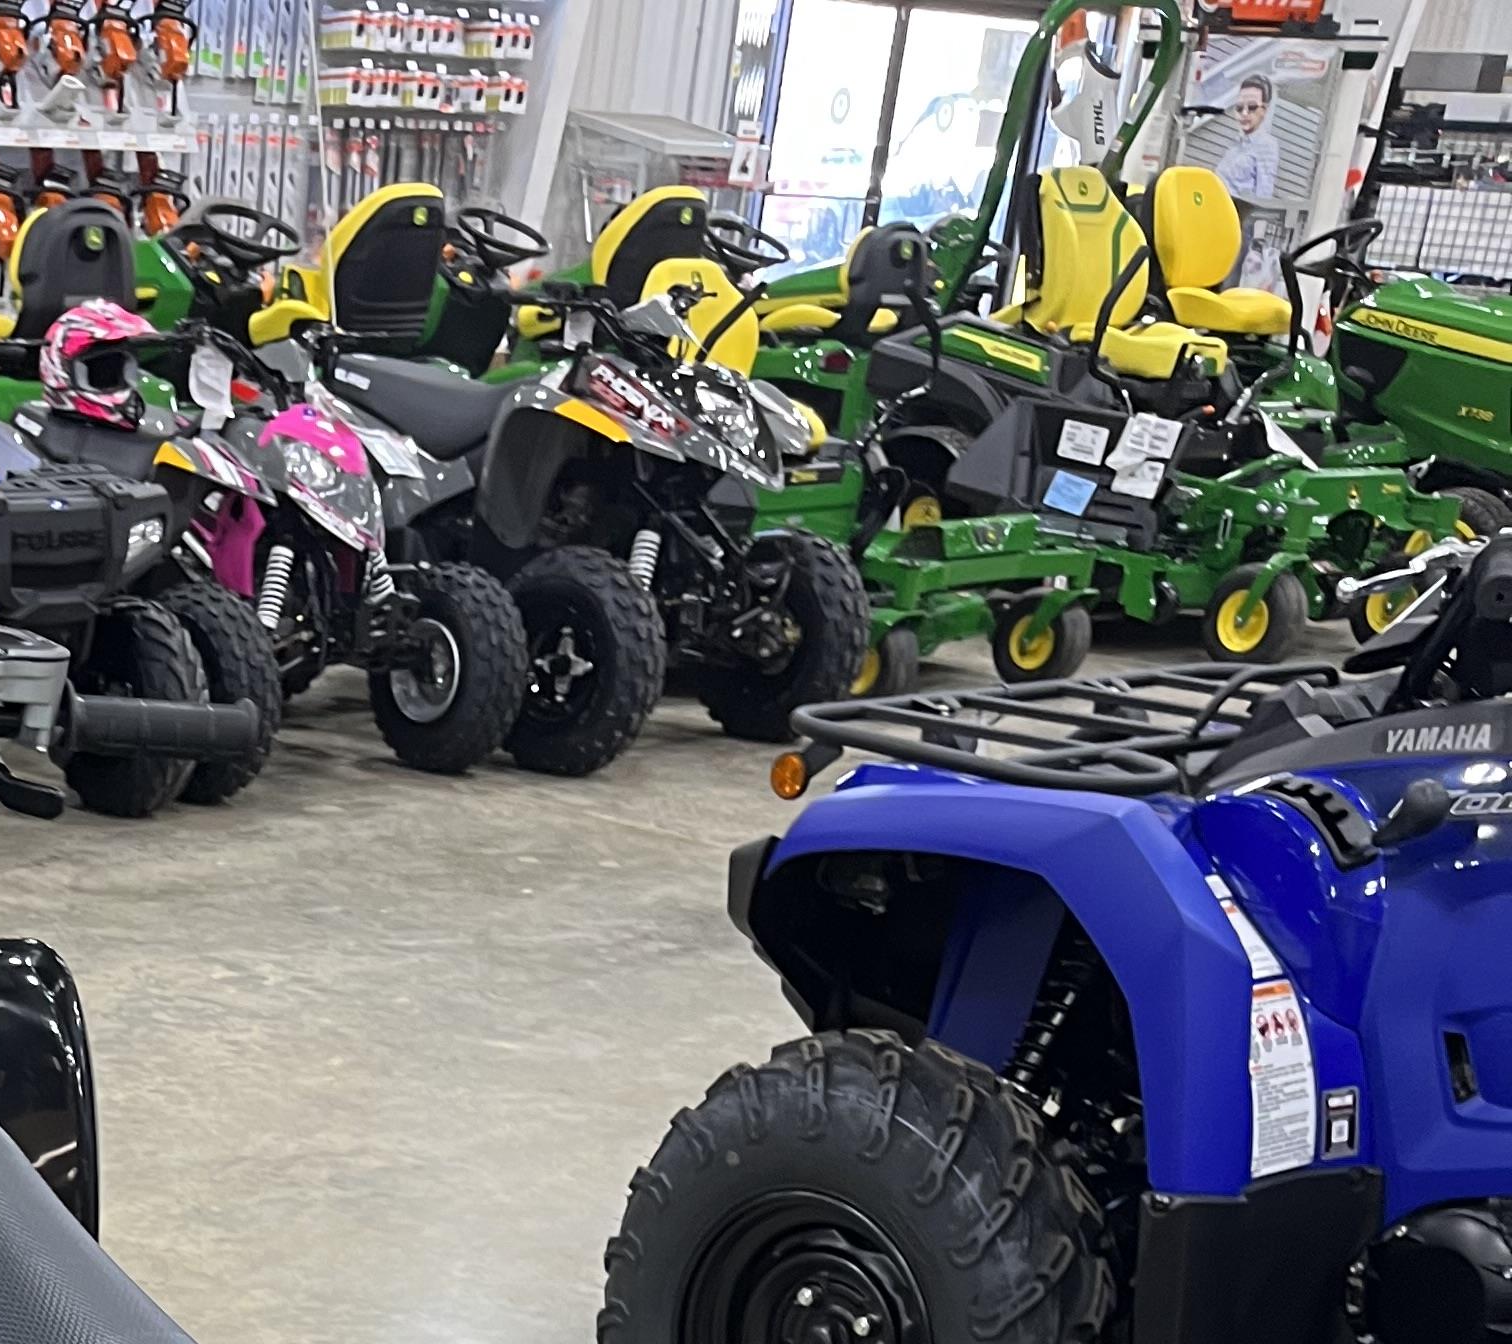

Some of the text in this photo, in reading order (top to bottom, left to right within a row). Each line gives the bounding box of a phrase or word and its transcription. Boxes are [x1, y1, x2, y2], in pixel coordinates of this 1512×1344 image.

[1093, 100, 1105, 145] STIHL
[1395, 320, 1439, 344] DEERE
[591, 364, 676, 433] PHOENIX
[1386, 723, 1492, 753] YAMAHA
